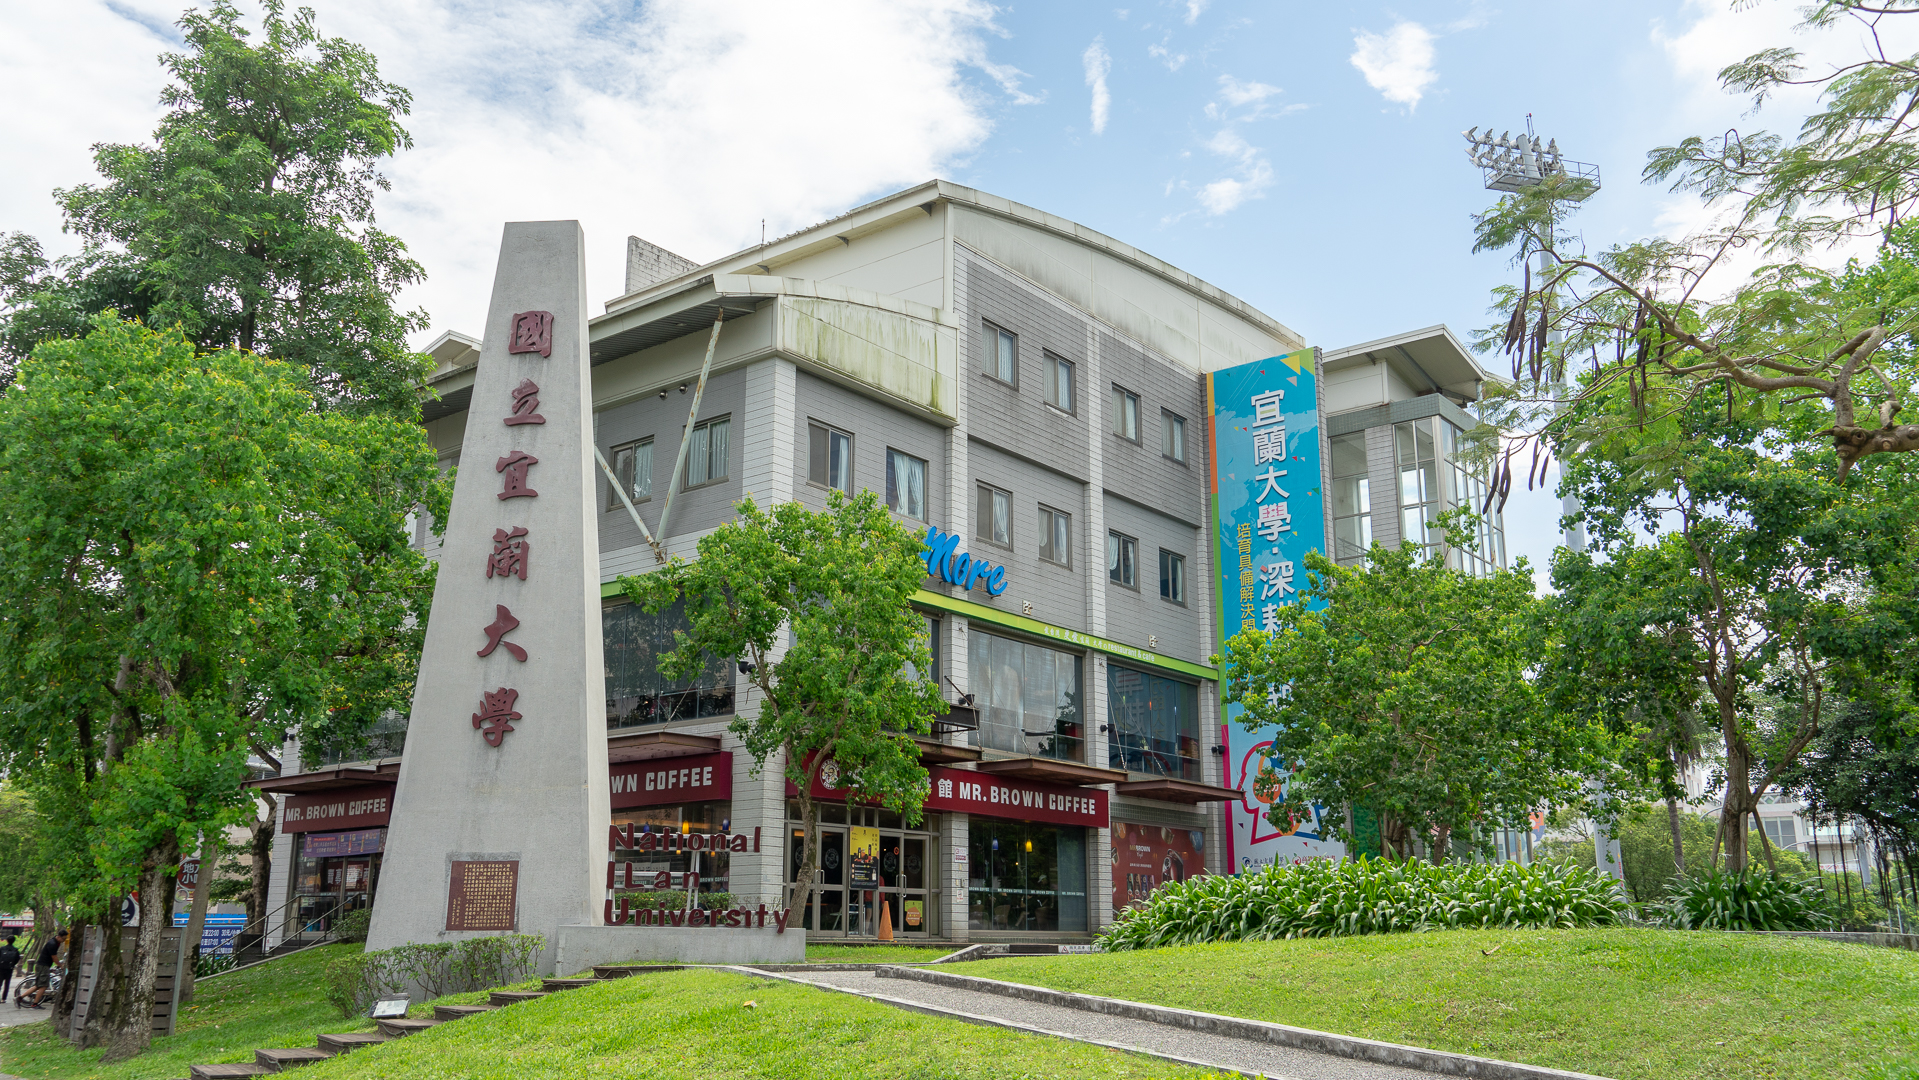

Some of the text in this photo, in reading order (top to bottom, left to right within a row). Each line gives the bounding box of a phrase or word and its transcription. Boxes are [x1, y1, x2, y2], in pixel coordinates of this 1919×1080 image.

[472, 310, 554, 747] 國立宜蘭大學
[919, 526, 1008, 595] More
[1108, 643, 1137, 656] restaurant
[645, 766, 713, 791] COFFEE
[285, 798, 387, 822] MR. BROWN COFFEE
[959, 782, 987, 802] MR.
[990, 785, 1043, 809] BROWN
[1049, 793, 1096, 815] COFFEE
[608, 822, 761, 853] National
[604, 898, 791, 934] University
